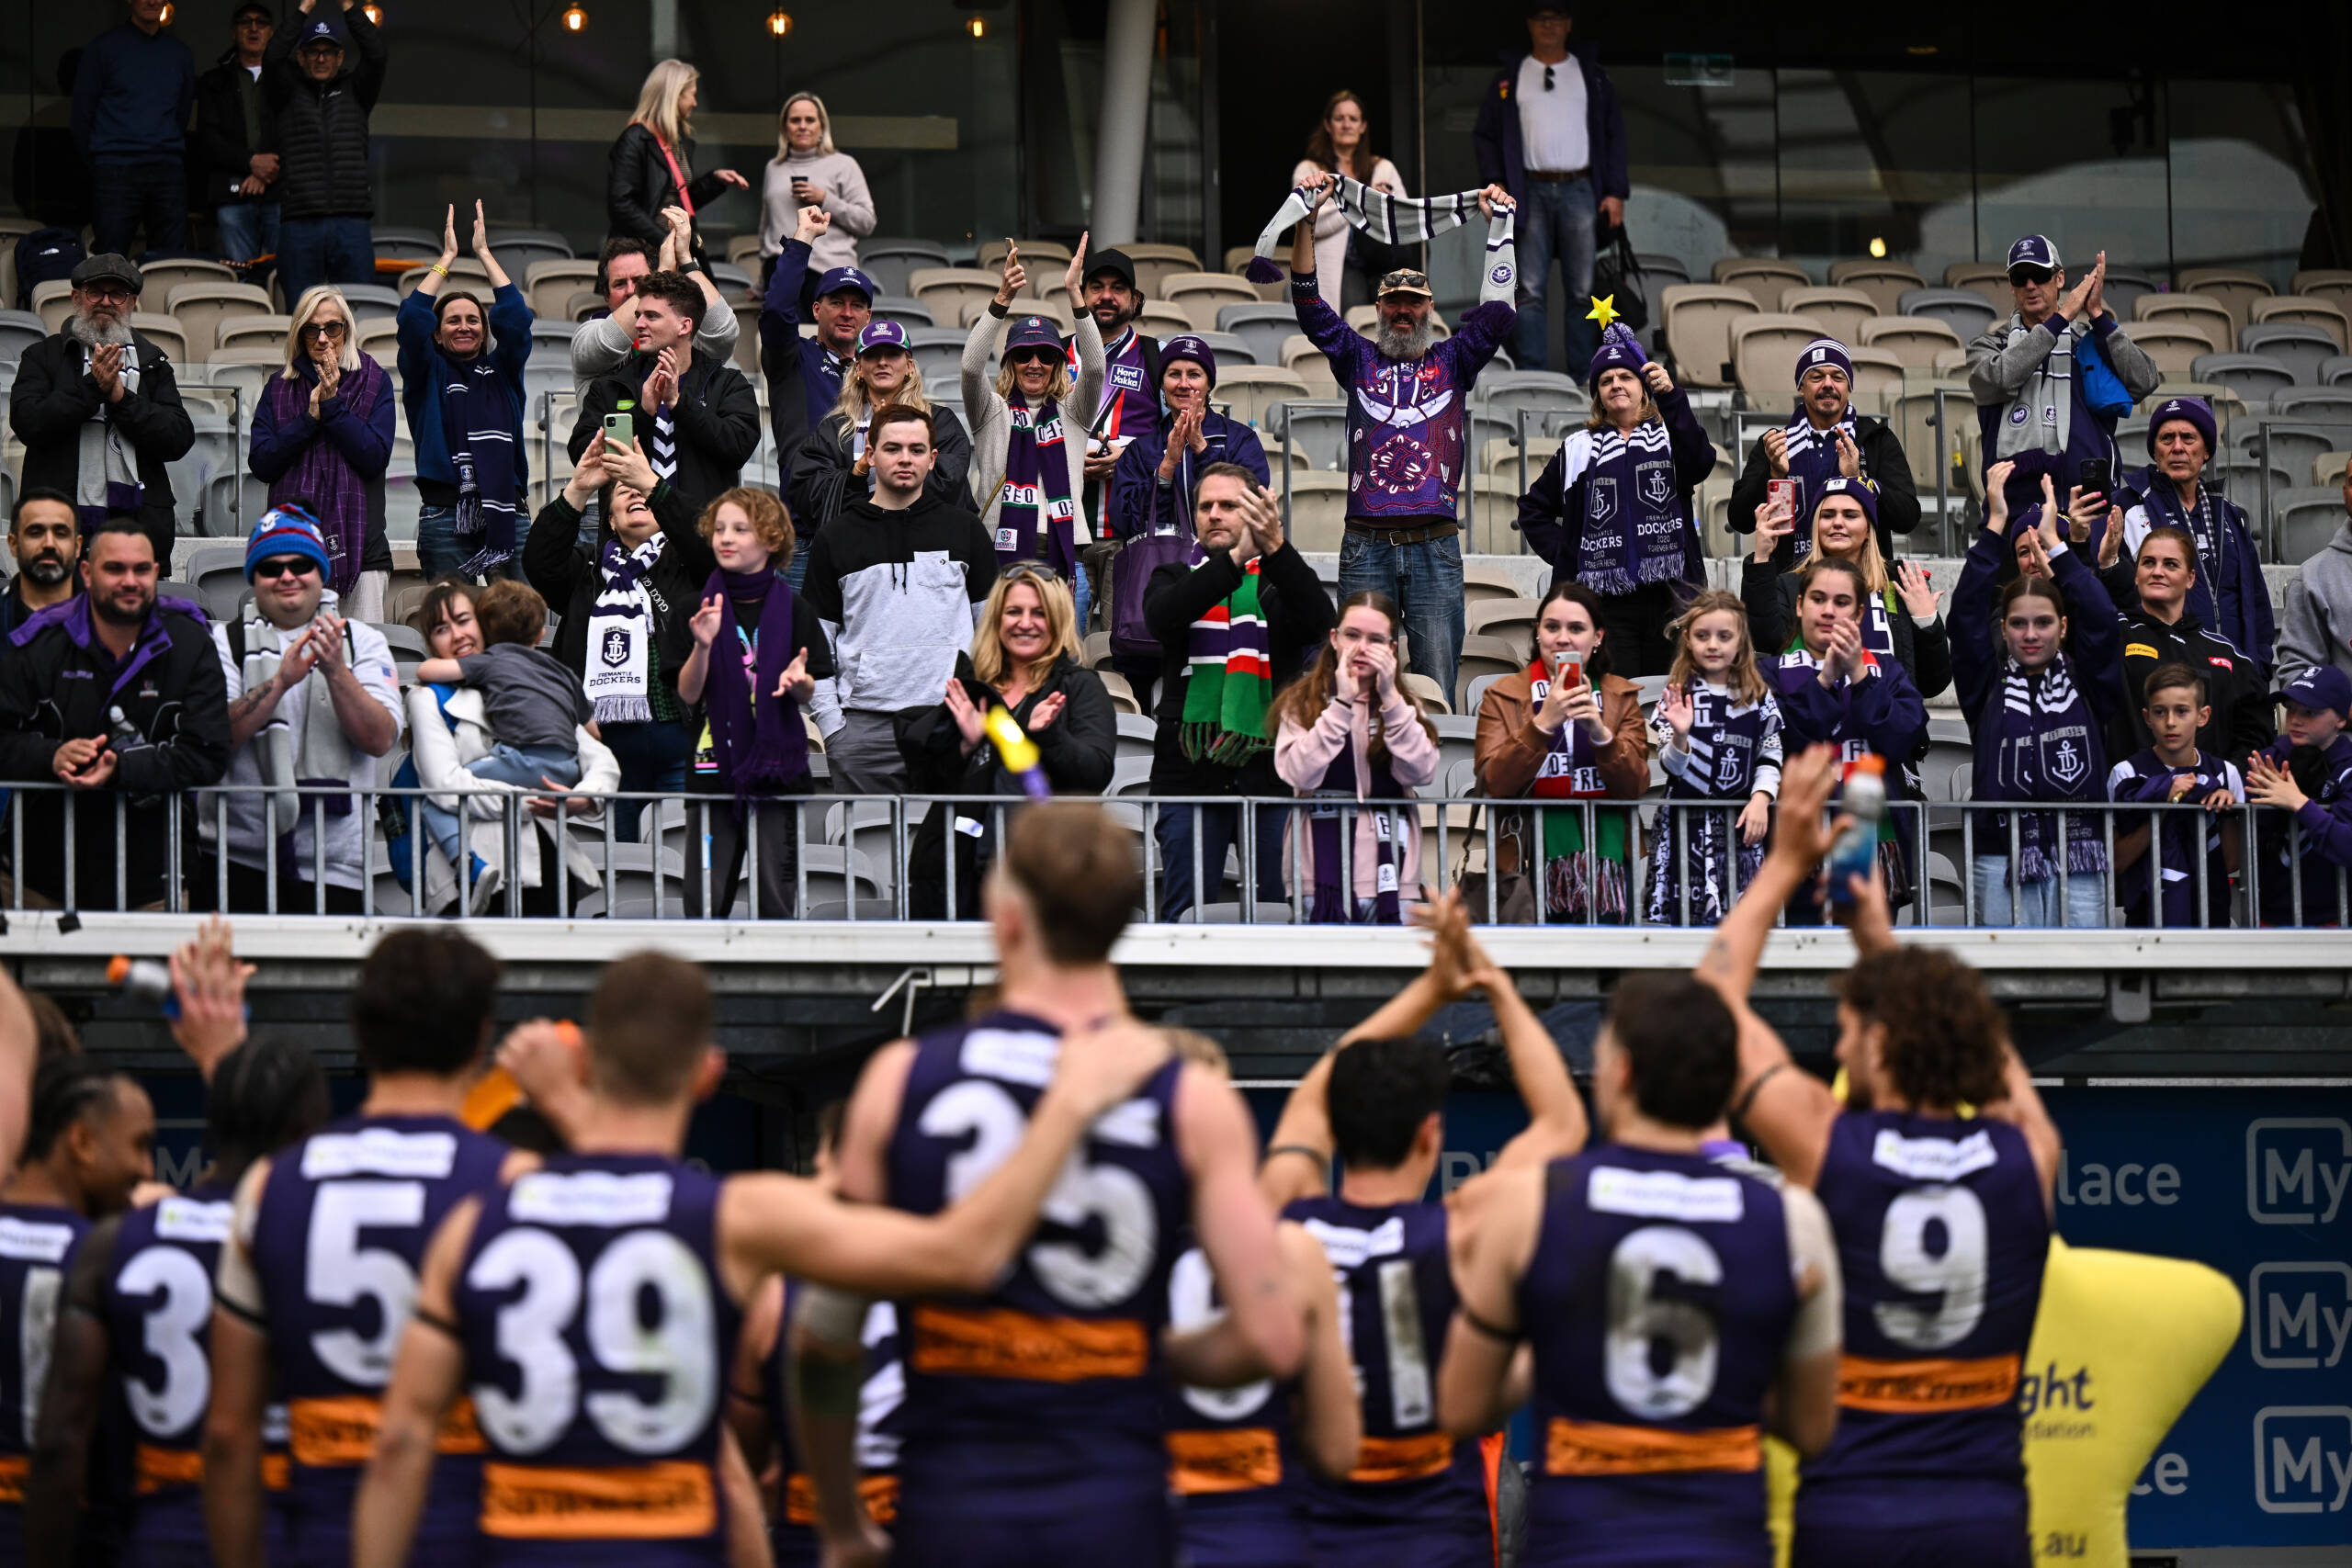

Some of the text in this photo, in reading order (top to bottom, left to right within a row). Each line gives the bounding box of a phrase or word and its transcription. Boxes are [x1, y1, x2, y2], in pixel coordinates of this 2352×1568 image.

[1113, 375, 1137, 387] Yakka
[1116, 367, 1137, 378] Hard
[1637, 517, 1683, 536] DOCKERS
[650, 588, 669, 613] GUCCI
[589, 677, 640, 687] DOCKERS
[2265, 1148, 2352, 1224] My
[306, 1180, 425, 1387] 5
[1872, 1185, 1989, 1350] 9
[467, 1227, 720, 1457] 39
[1604, 1226, 1724, 1421] 6
[2269, 1292, 2352, 1368] My
[2273, 1437, 2352, 1513] My
